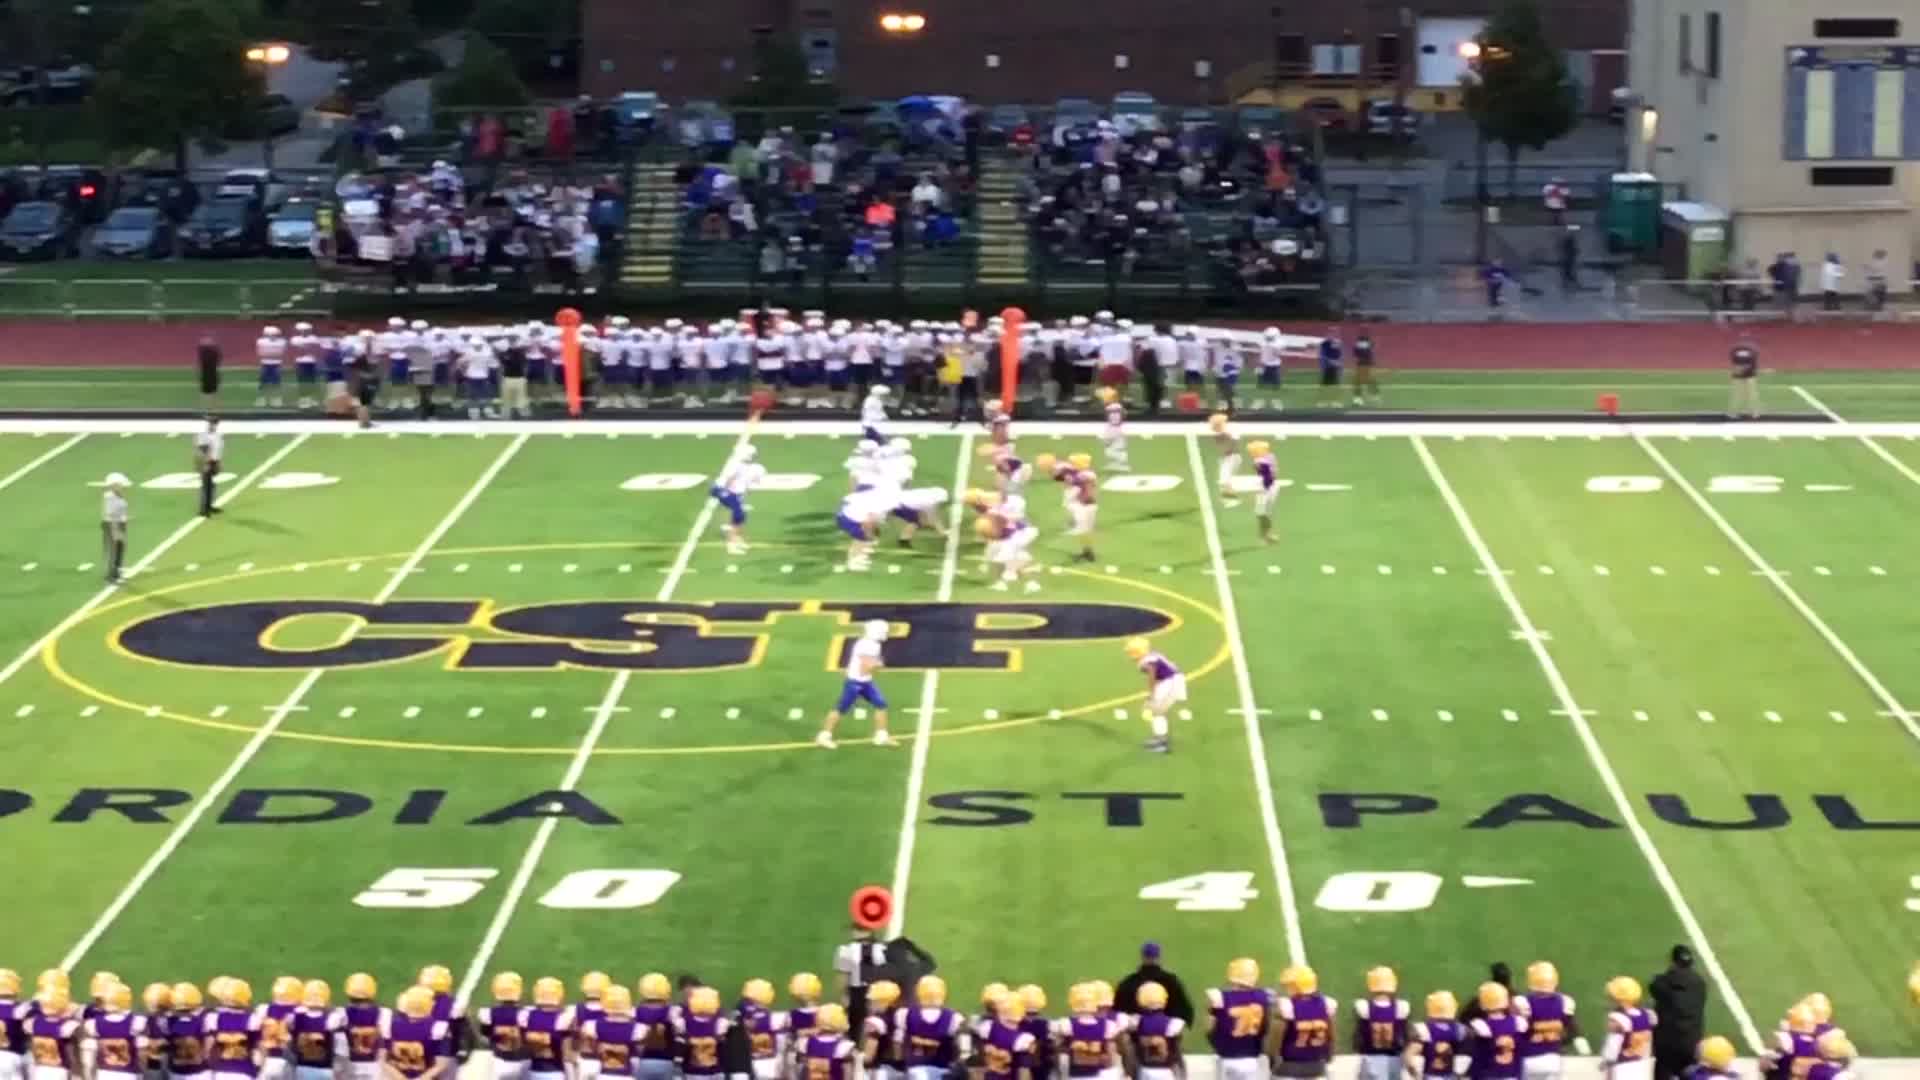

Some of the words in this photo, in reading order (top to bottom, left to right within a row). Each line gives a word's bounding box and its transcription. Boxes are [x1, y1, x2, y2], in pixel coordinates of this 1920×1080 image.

[110, 597, 1184, 672] CSP
[925, 791, 1184, 827] ST
[1317, 792, 1920, 831] PAUL
